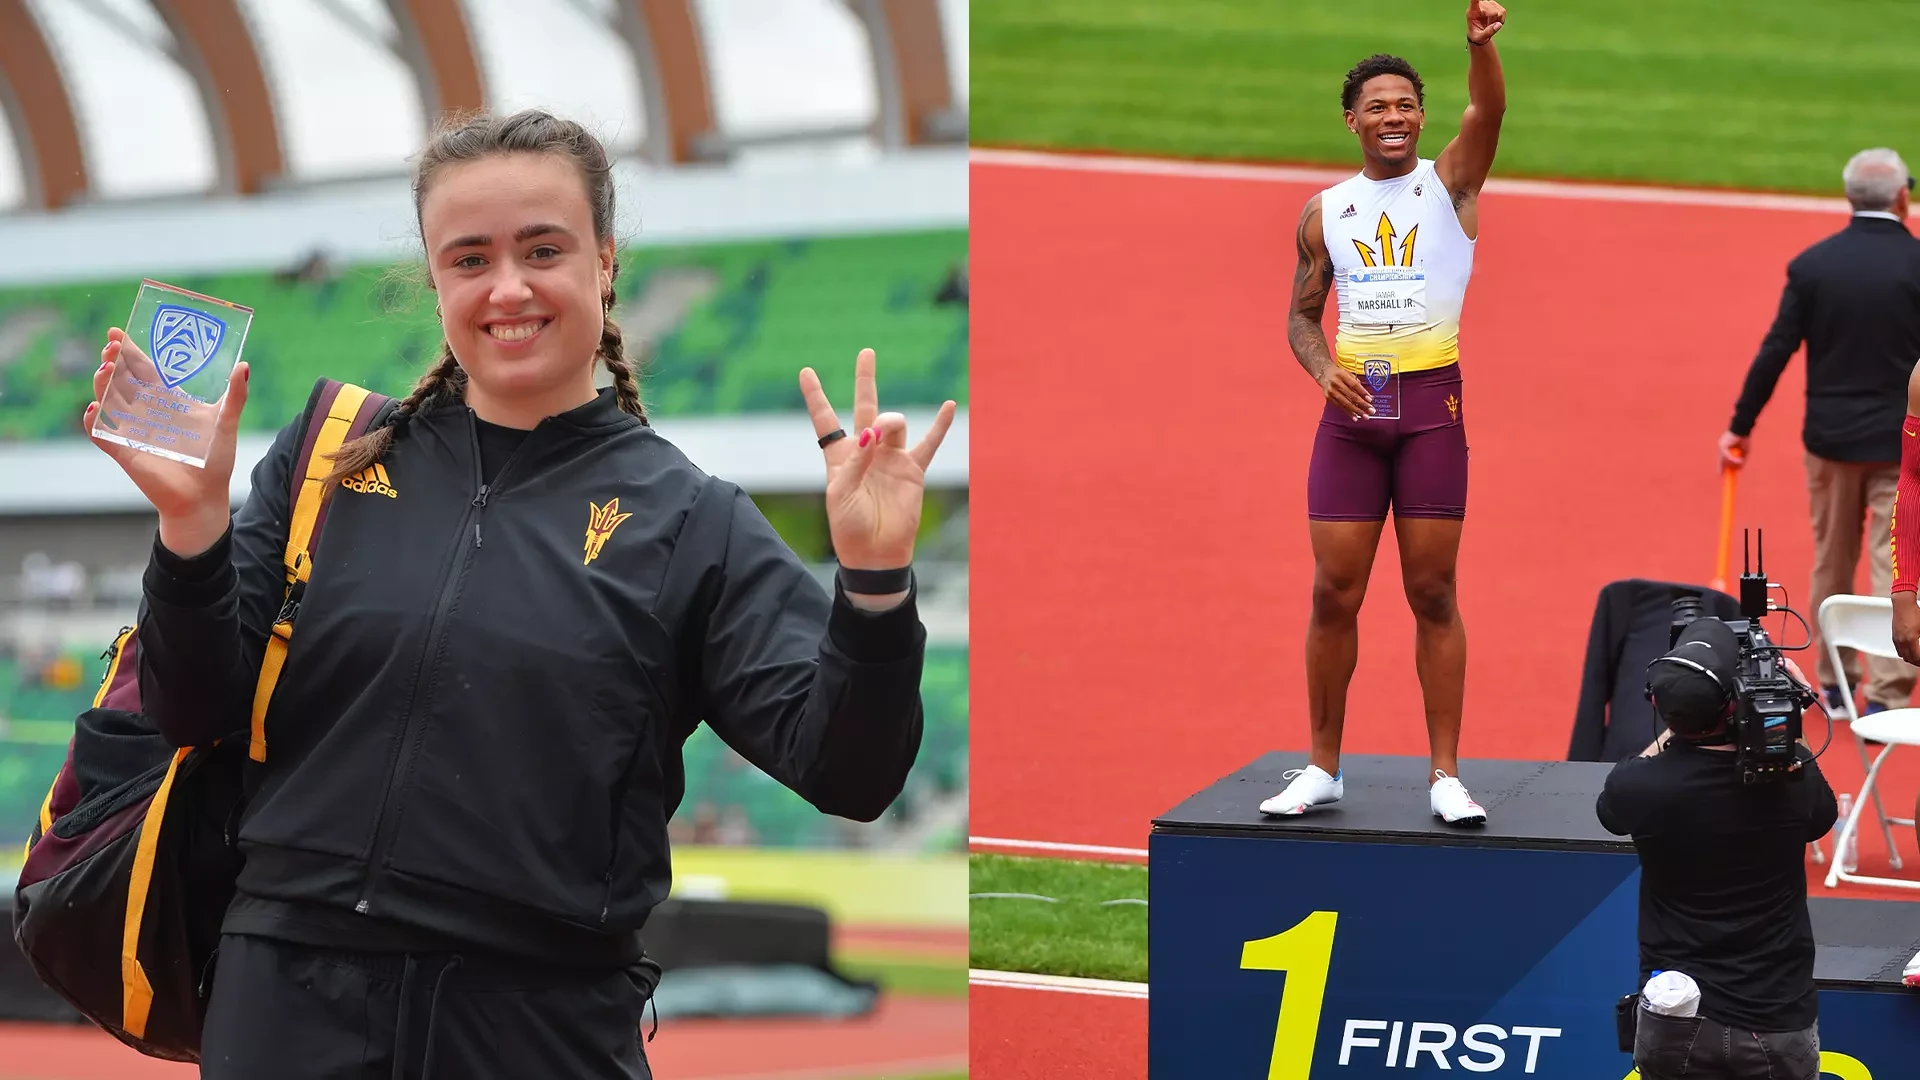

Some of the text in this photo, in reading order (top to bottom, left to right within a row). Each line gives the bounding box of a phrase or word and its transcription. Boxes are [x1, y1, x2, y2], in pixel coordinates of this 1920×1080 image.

[1369, 273, 1416, 282] CHAMPIONSHIPS
[1357, 297, 1416, 310] MARSHALL JR.
[1375, 290, 1396, 299] JAMAR
[164, 349, 192, 373] 12
[135, 391, 191, 414] 1ST PLACE
[341, 477, 398, 499] adidas
[1240, 911, 1338, 1080] 1
[1338, 1019, 1562, 1074] FIRST
